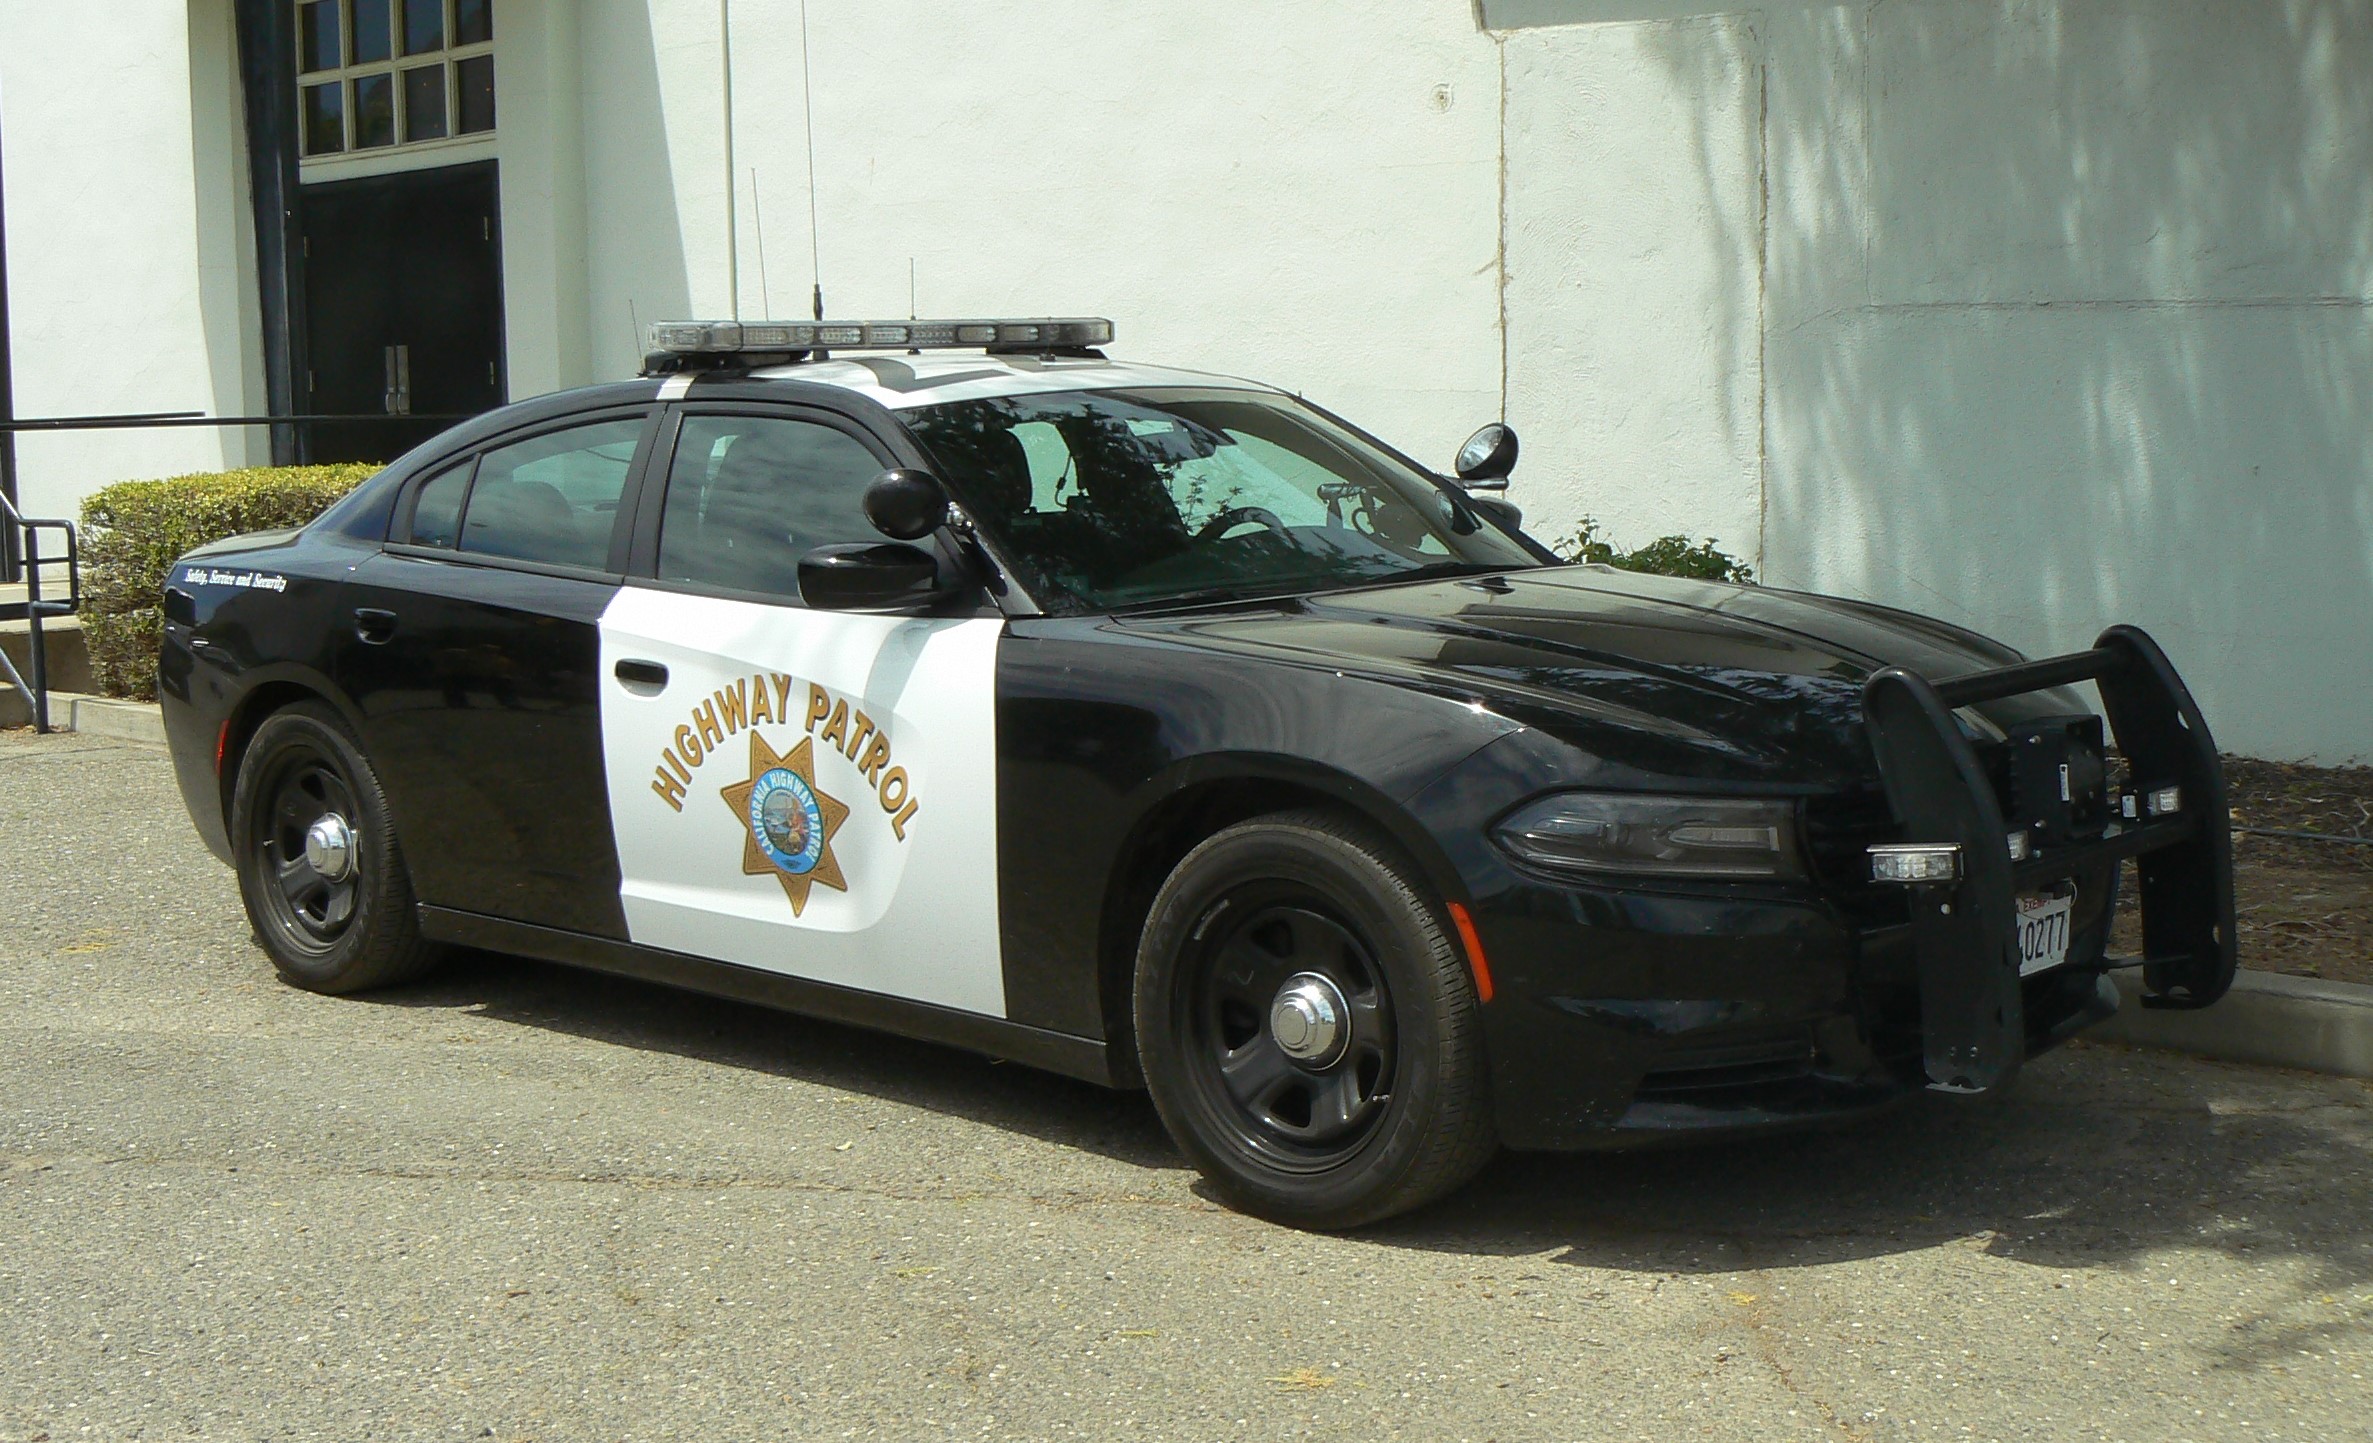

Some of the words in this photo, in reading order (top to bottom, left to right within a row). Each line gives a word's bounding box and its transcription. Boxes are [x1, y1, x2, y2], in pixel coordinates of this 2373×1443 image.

[184, 568, 208, 586] Safety,
[209, 569, 235, 586] Service
[235, 572, 252, 587] and
[252, 573, 288, 593] Security
[651, 673, 792, 813] HIGHWAY
[805, 682, 920, 842] PATROL
[751, 780, 775, 855] CALIFORNIA
[769, 772, 813, 808] HIGHWAY
[805, 812, 822, 863] PATROL
[2017, 911, 2065, 962] 0277
